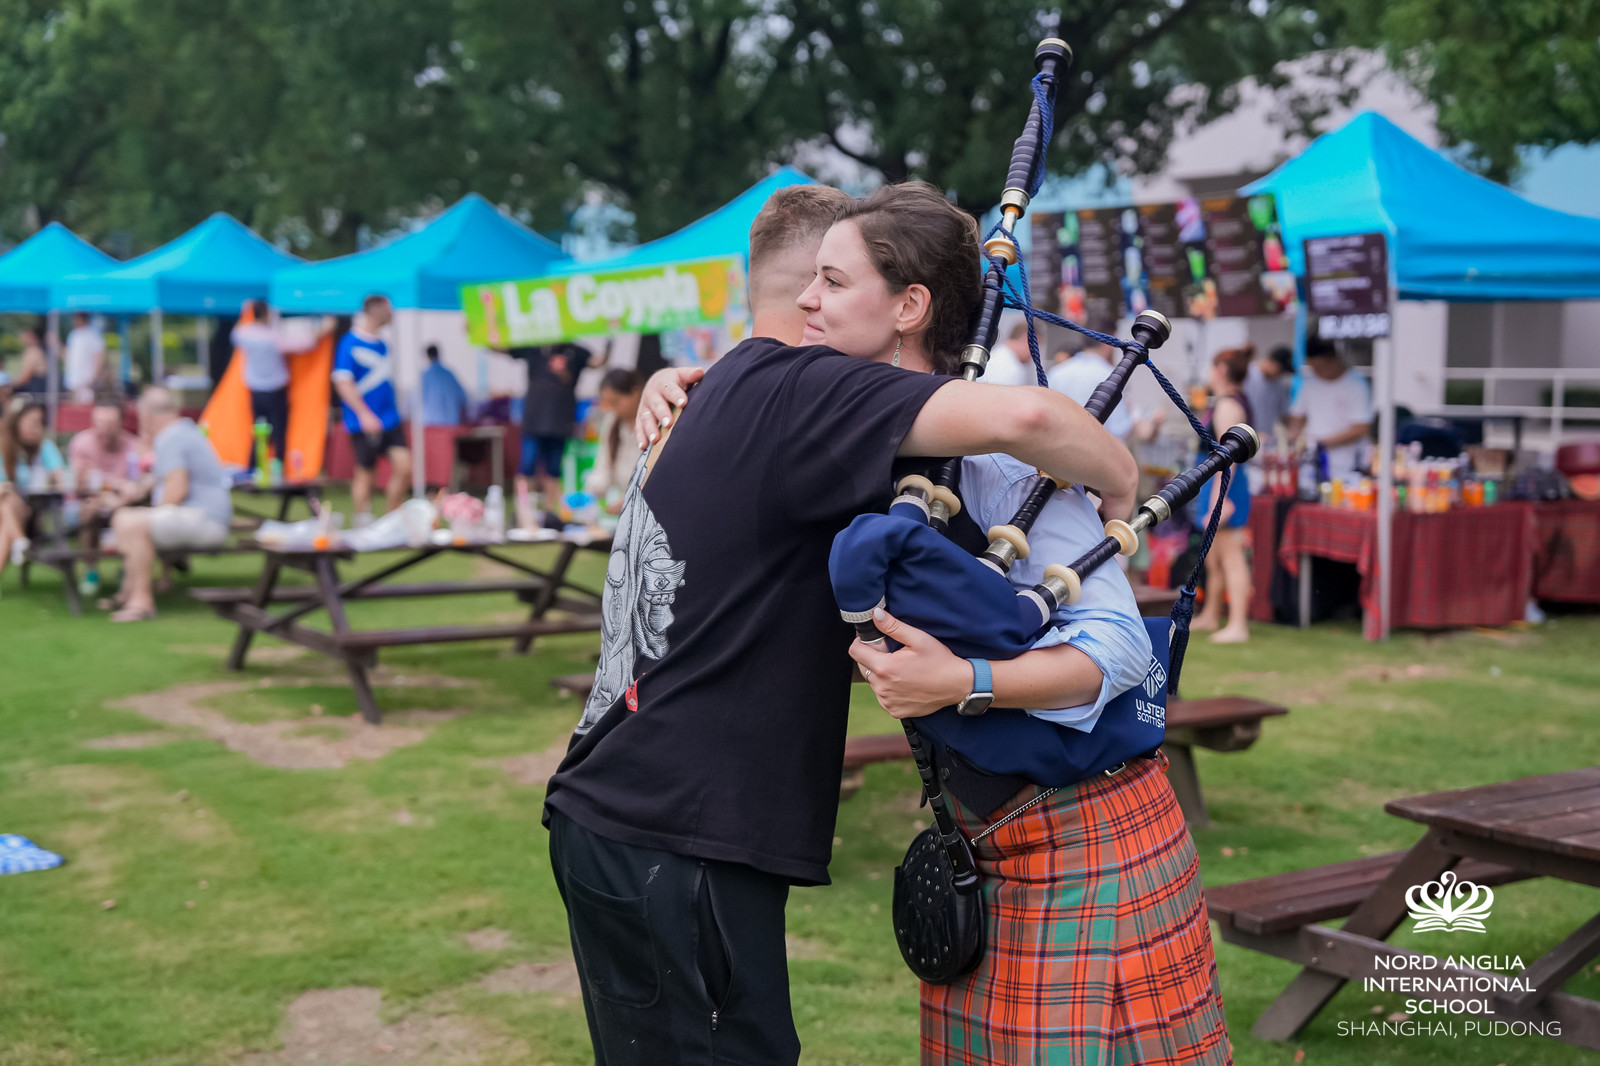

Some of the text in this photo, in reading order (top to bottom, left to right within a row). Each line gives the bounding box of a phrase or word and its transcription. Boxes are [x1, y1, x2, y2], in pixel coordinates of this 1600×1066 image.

[502, 282, 559, 323] La
[1135, 698, 1166, 720] ULSTER
[1136, 711, 1165, 730] SCOTTISH
